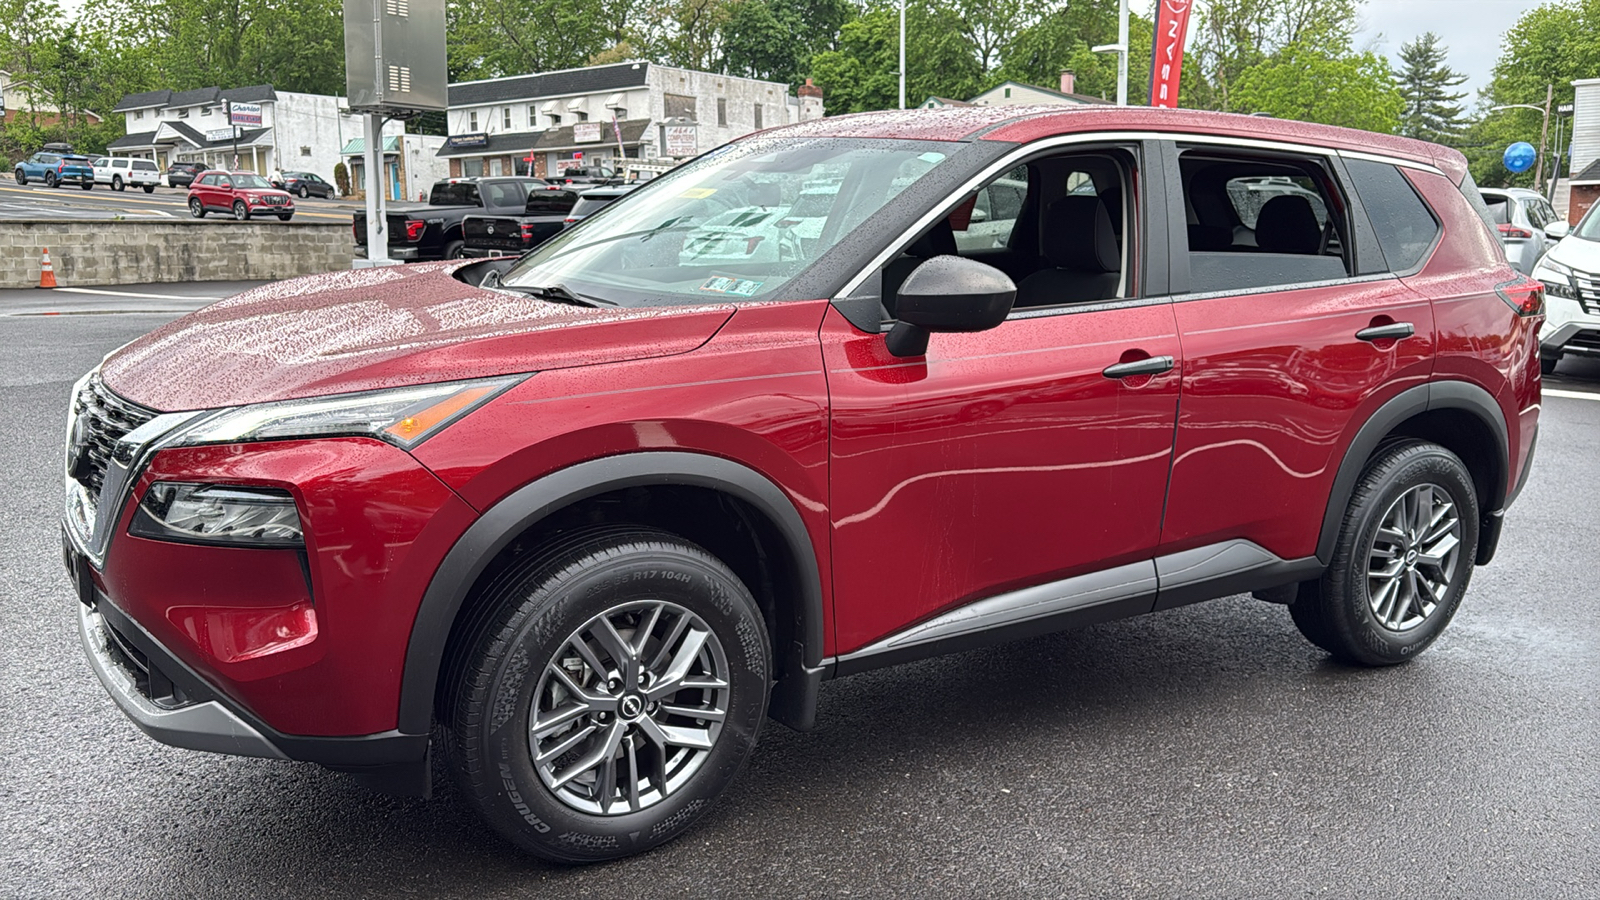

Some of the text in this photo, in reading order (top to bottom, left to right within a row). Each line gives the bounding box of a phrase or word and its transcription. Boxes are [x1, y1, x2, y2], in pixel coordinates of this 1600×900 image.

[1557, 104, 1573, 112] HAIR
[632, 570, 658, 581] R17
[661, 570, 692, 583] 104H
[498, 762, 551, 833] CRUGEN
